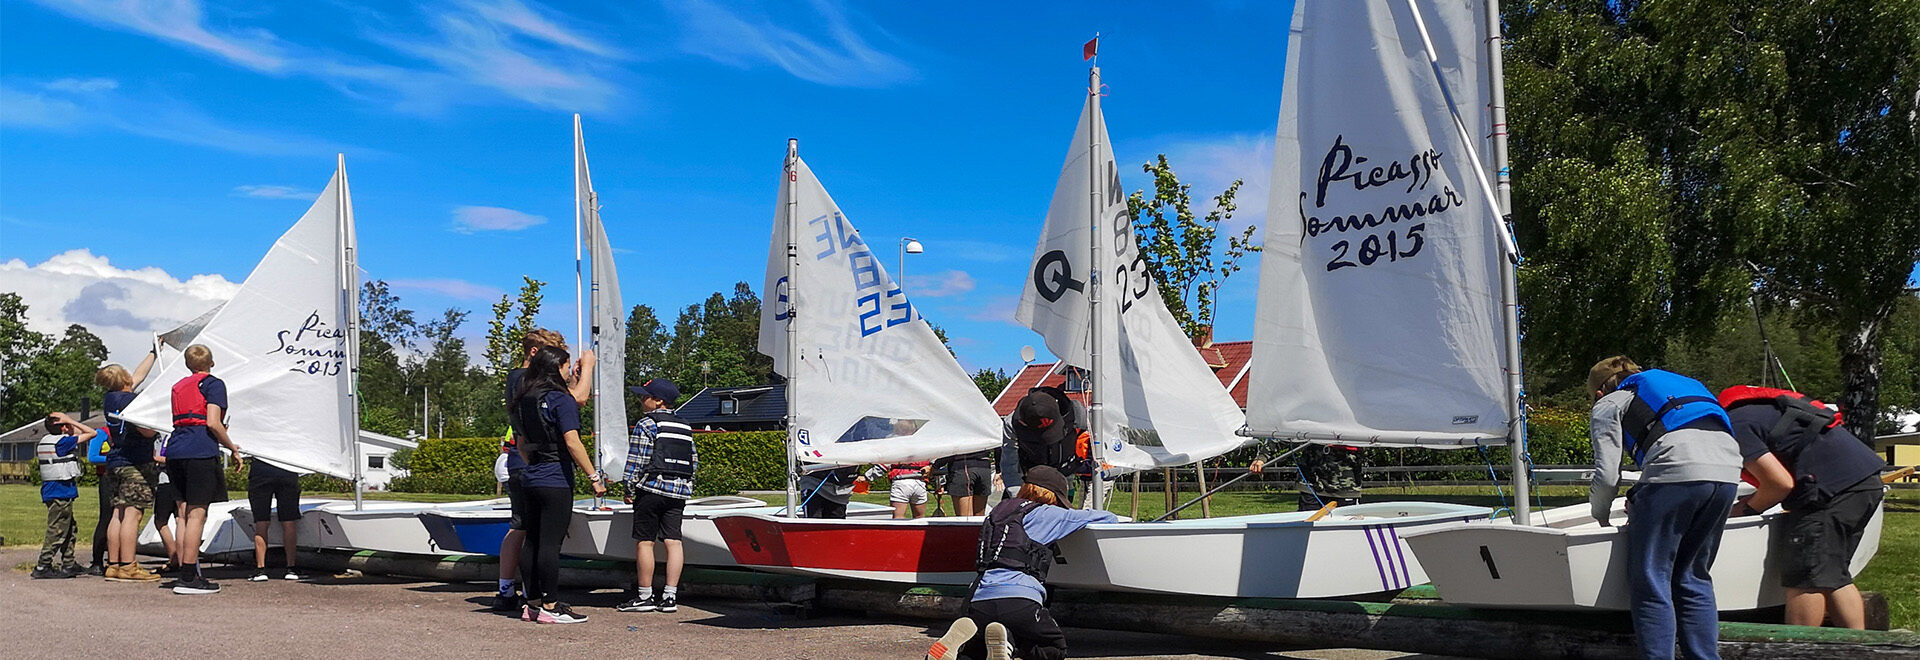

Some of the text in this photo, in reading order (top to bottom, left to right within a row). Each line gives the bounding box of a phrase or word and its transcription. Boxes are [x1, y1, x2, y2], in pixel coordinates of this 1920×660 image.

[790, 170, 797, 183] 6
[1316, 134, 1442, 208] Picasso
[1299, 185, 1463, 248] Sommar
[1327, 222, 1425, 272] 2015
[1116, 254, 1150, 315] 23
[857, 288, 922, 338] 23
[289, 360, 343, 376] 2015
[1480, 544, 1501, 580] 1
